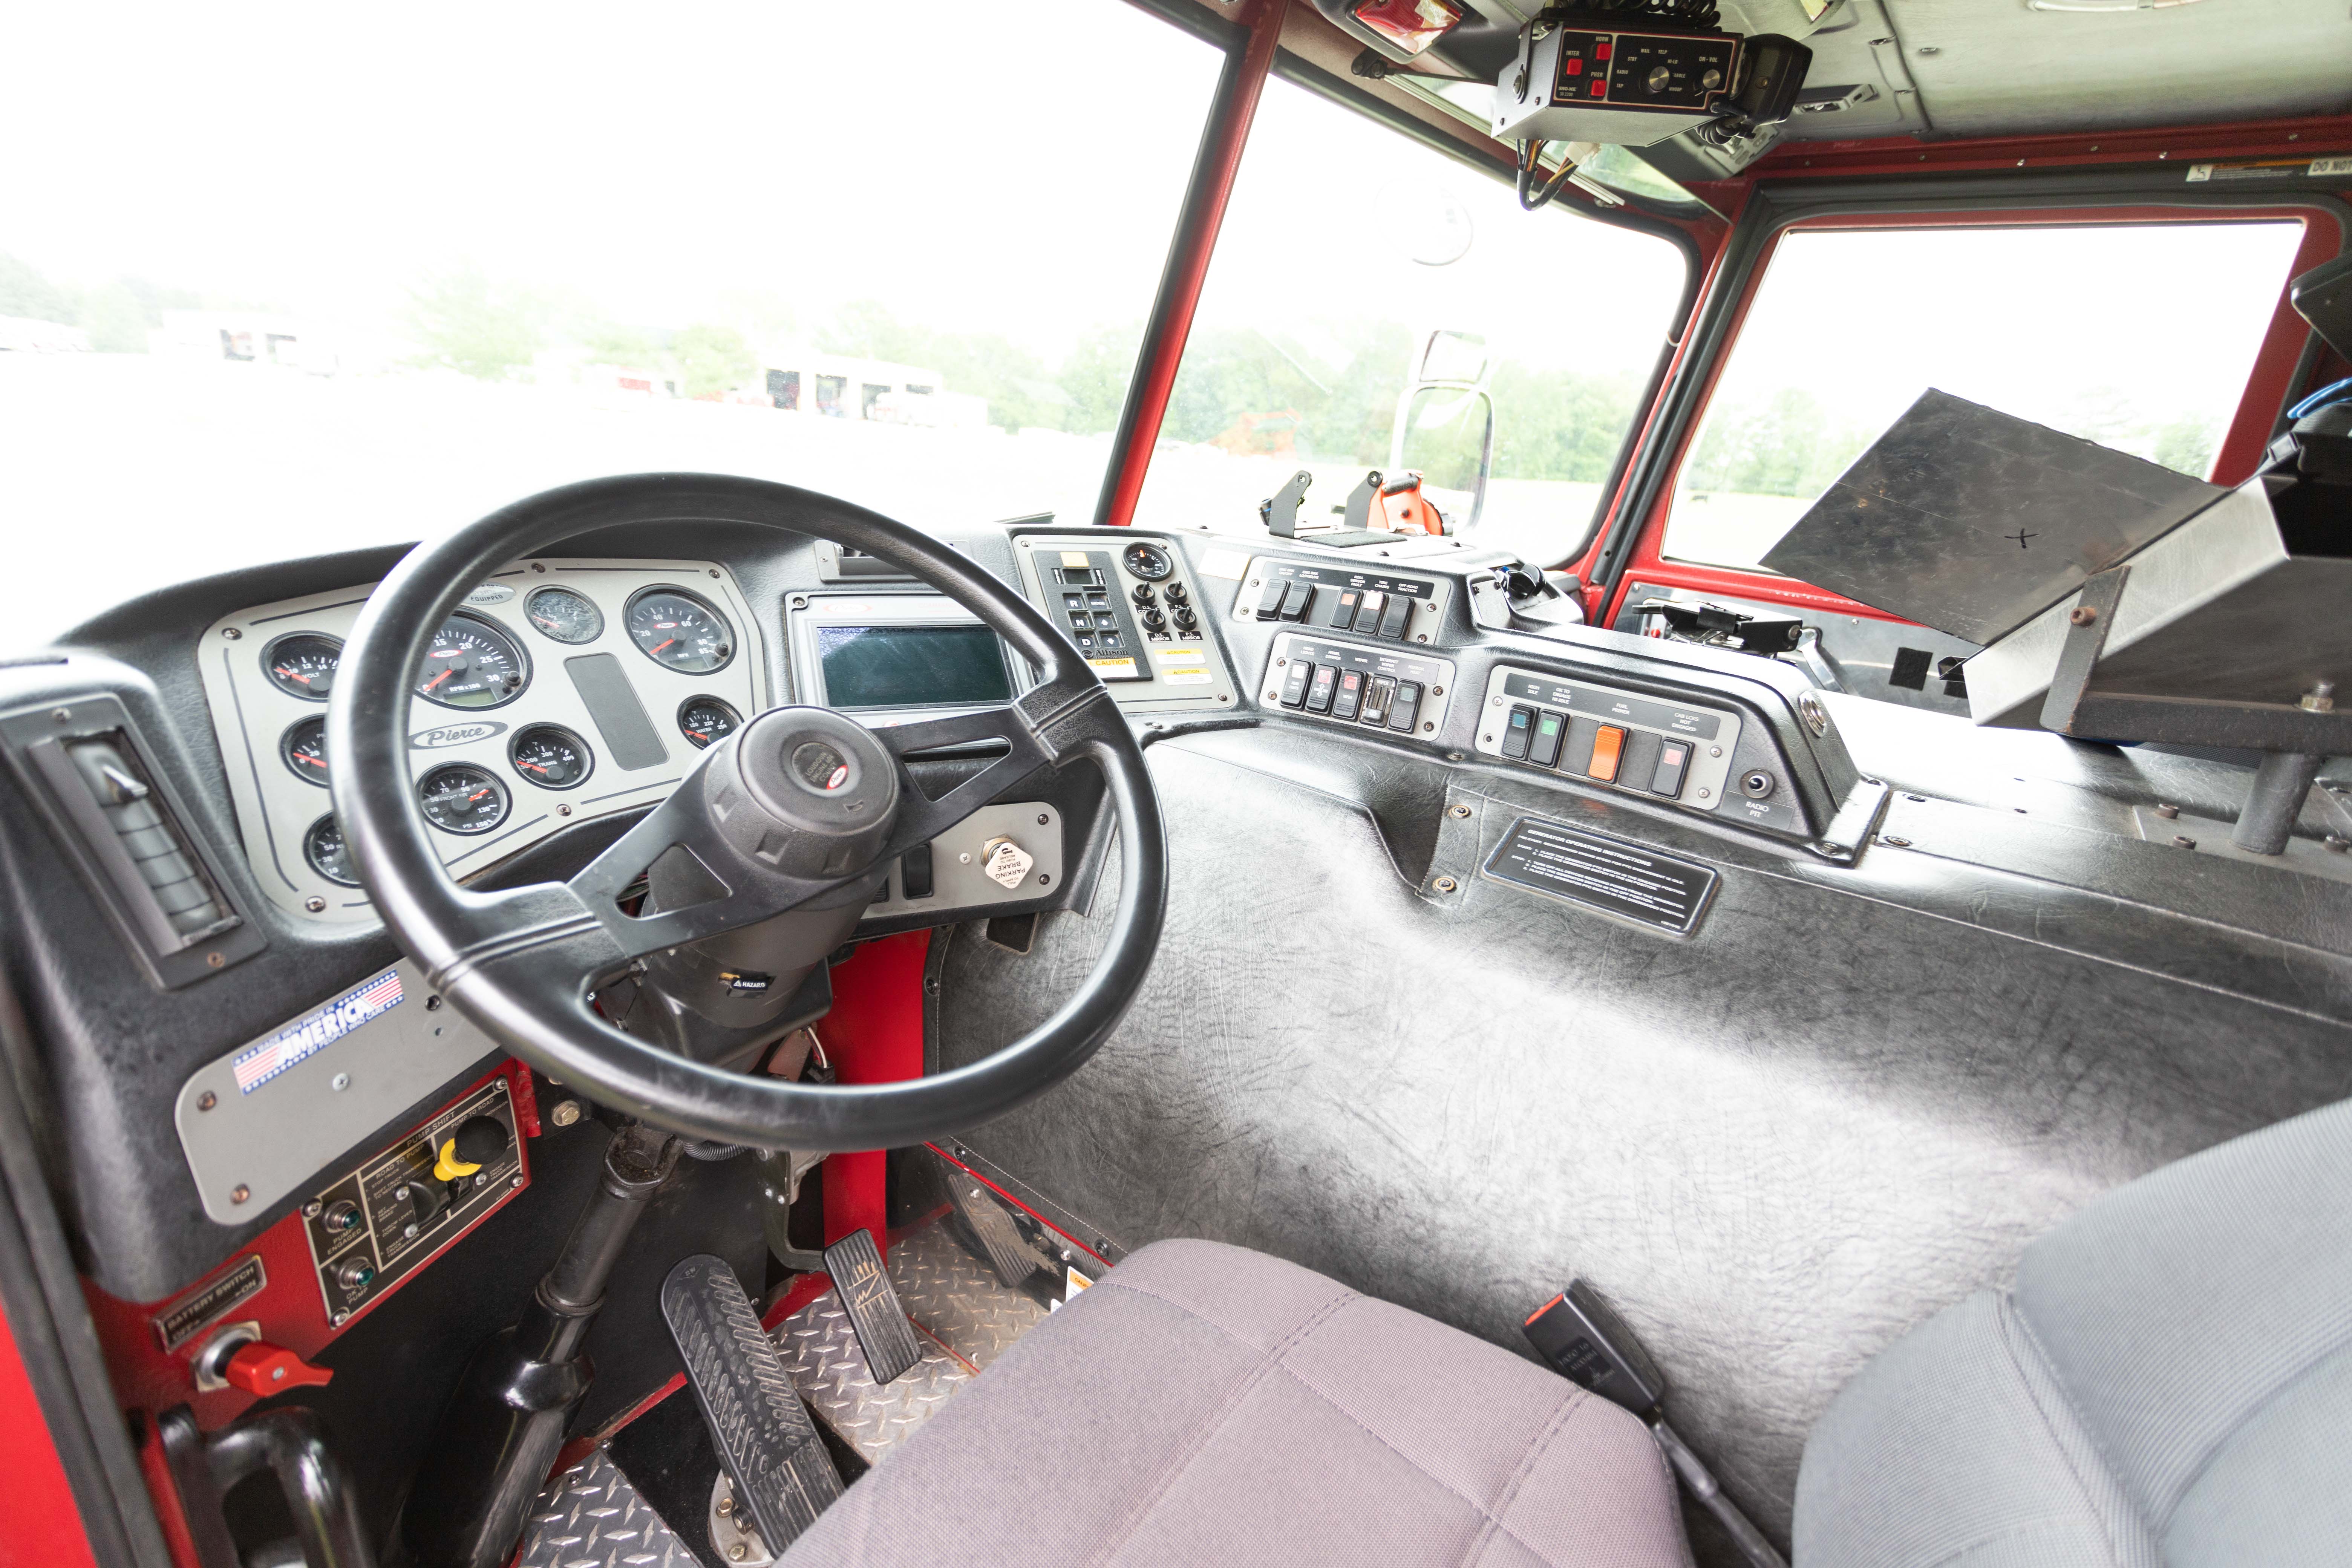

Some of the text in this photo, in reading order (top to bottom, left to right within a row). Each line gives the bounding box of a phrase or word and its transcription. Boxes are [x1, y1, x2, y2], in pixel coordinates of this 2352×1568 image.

[427, 727, 485, 746] Pierce
[1671, 723, 1696, 732] ENGAGED
[805, 752, 827, 776] LOUDOUN
[810, 763, 827, 782] ENGINE
[819, 761, 837, 781] COUNTY
[1746, 801, 1769, 812] RADIO
[1528, 829, 1652, 867] GENERATOR OPERATING INSTRUCTIONS
[997, 861, 1021, 871] BRAKE
[1543, 842, 1578, 853] RECOMMENDED
[1632, 867, 1666, 879] ENGAGEMENT
[995, 868, 1025, 879] PARKING
[257, 1005, 335, 1053] MADE WITH PRIDE IN
[276, 997, 375, 1066] AMERICA
[307, 1005, 386, 1055] BY PEOPLE WHO CARE
[451, 1115, 467, 1129] PUMP
[478, 1098, 494, 1110] ROAD
[407, 1111, 455, 1147] PUMP SHIFT
[376, 1144, 424, 1179] ROAD TO PUMP
[491, 1160, 518, 1181] TRANSMISSION
[372, 1168, 399, 1188] STOP TRUCK
[374, 1186, 386, 1197] SHIFT
[387, 1176, 402, 1187] TRUCK
[399, 1209, 413, 1221] LEVER
[328, 1228, 361, 1255] ENGAGED
[333, 1228, 353, 1244] PUMP
[168, 1266, 254, 1329] BATTERY SWITCH
[346, 1289, 356, 1299] OK
[349, 1287, 368, 1305] PUMP
